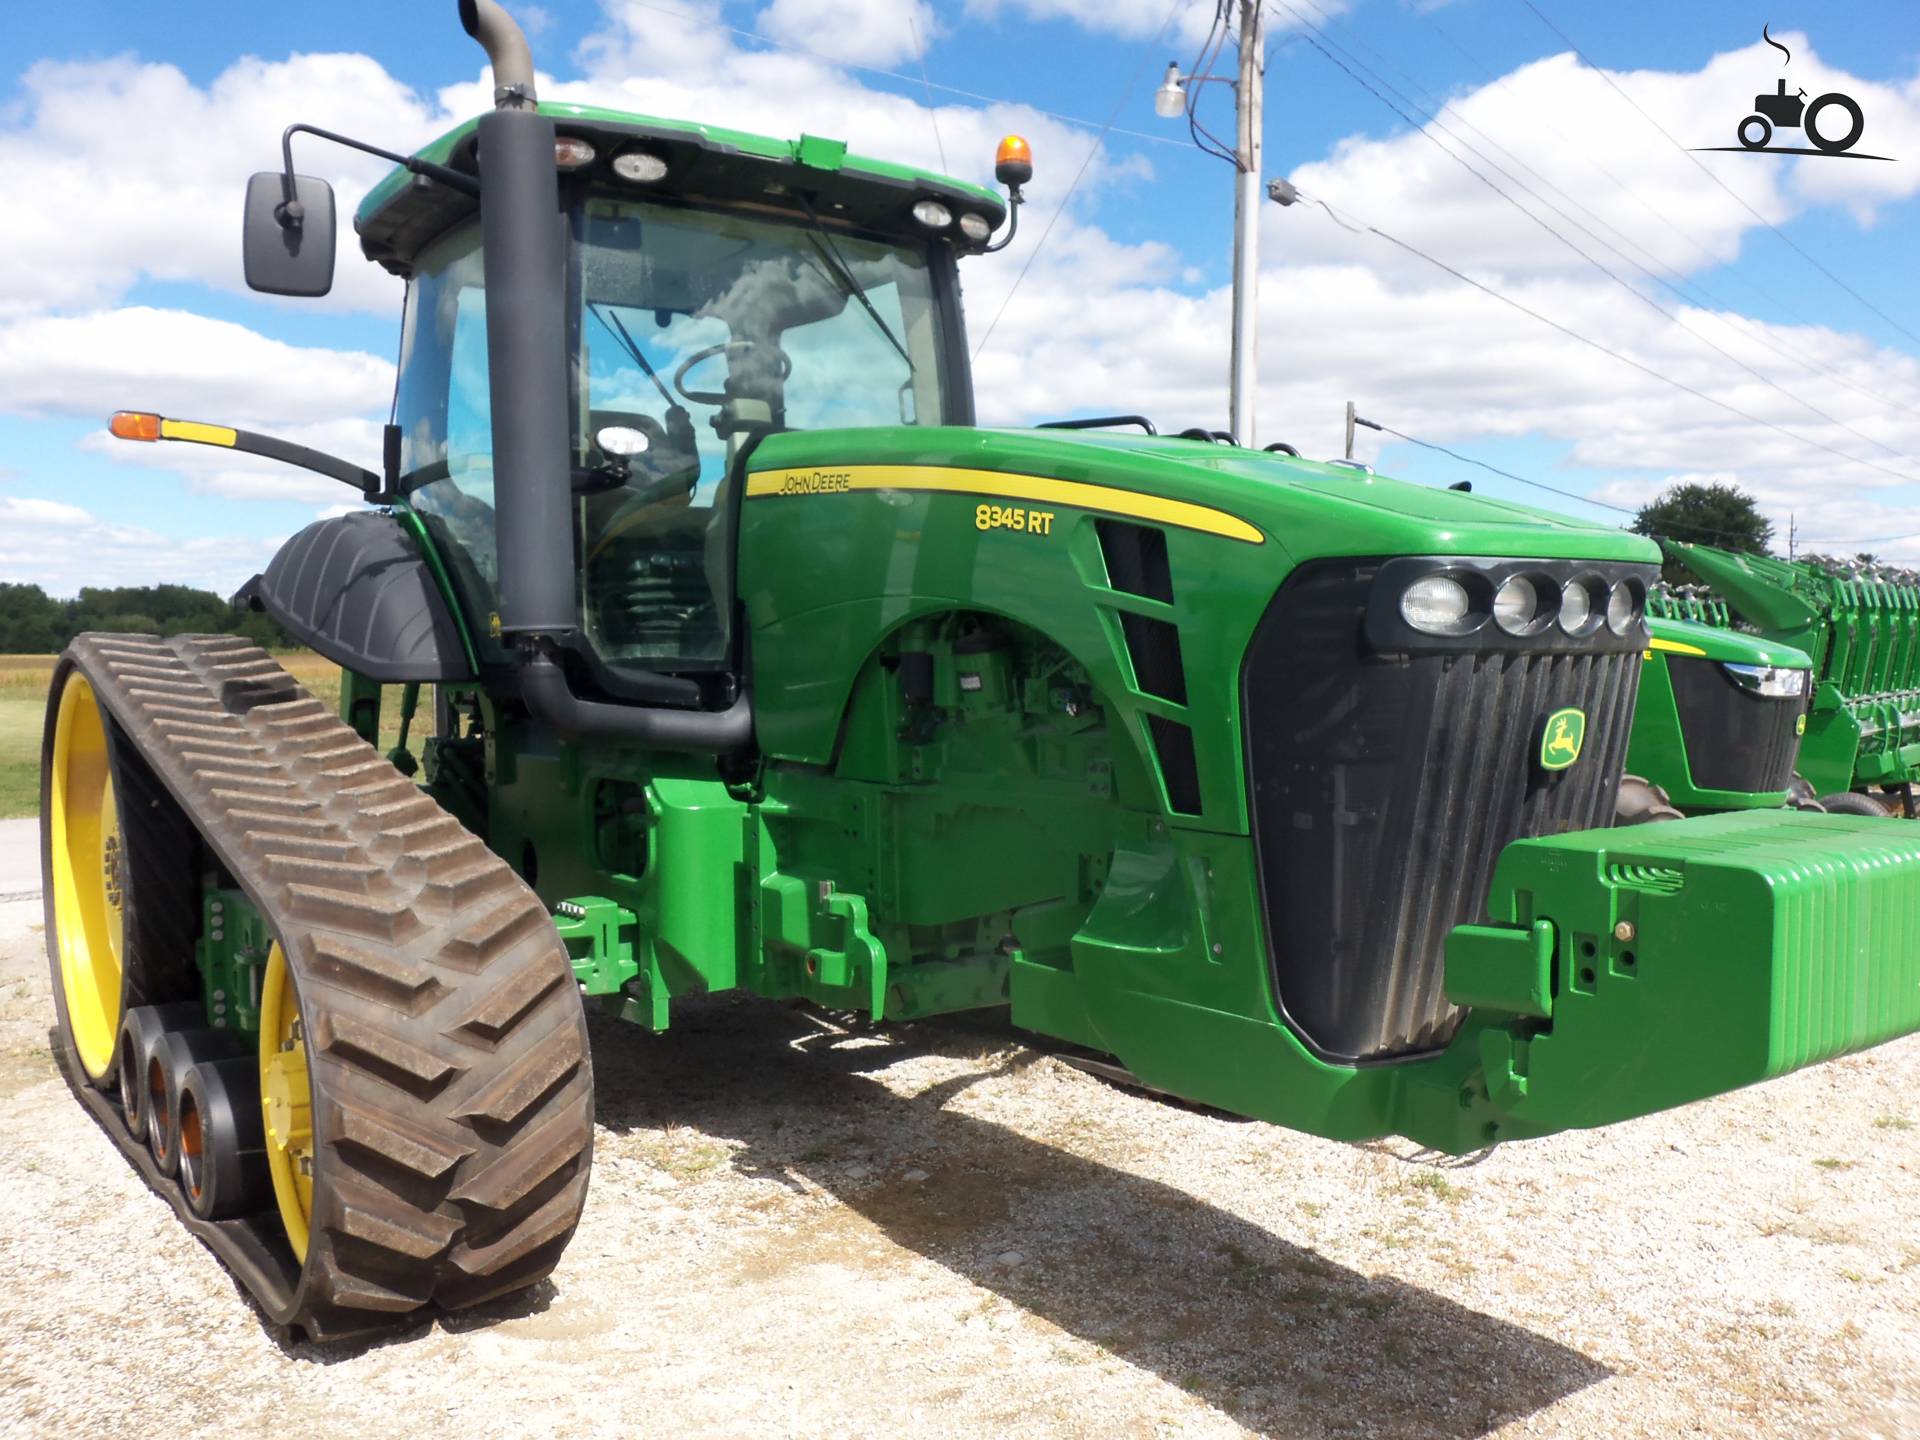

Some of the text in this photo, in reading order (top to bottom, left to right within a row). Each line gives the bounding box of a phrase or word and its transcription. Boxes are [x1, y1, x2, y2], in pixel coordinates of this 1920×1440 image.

[780, 471, 850, 493] JOHN DEERE
[975, 504, 1054, 535] 8345 RT
